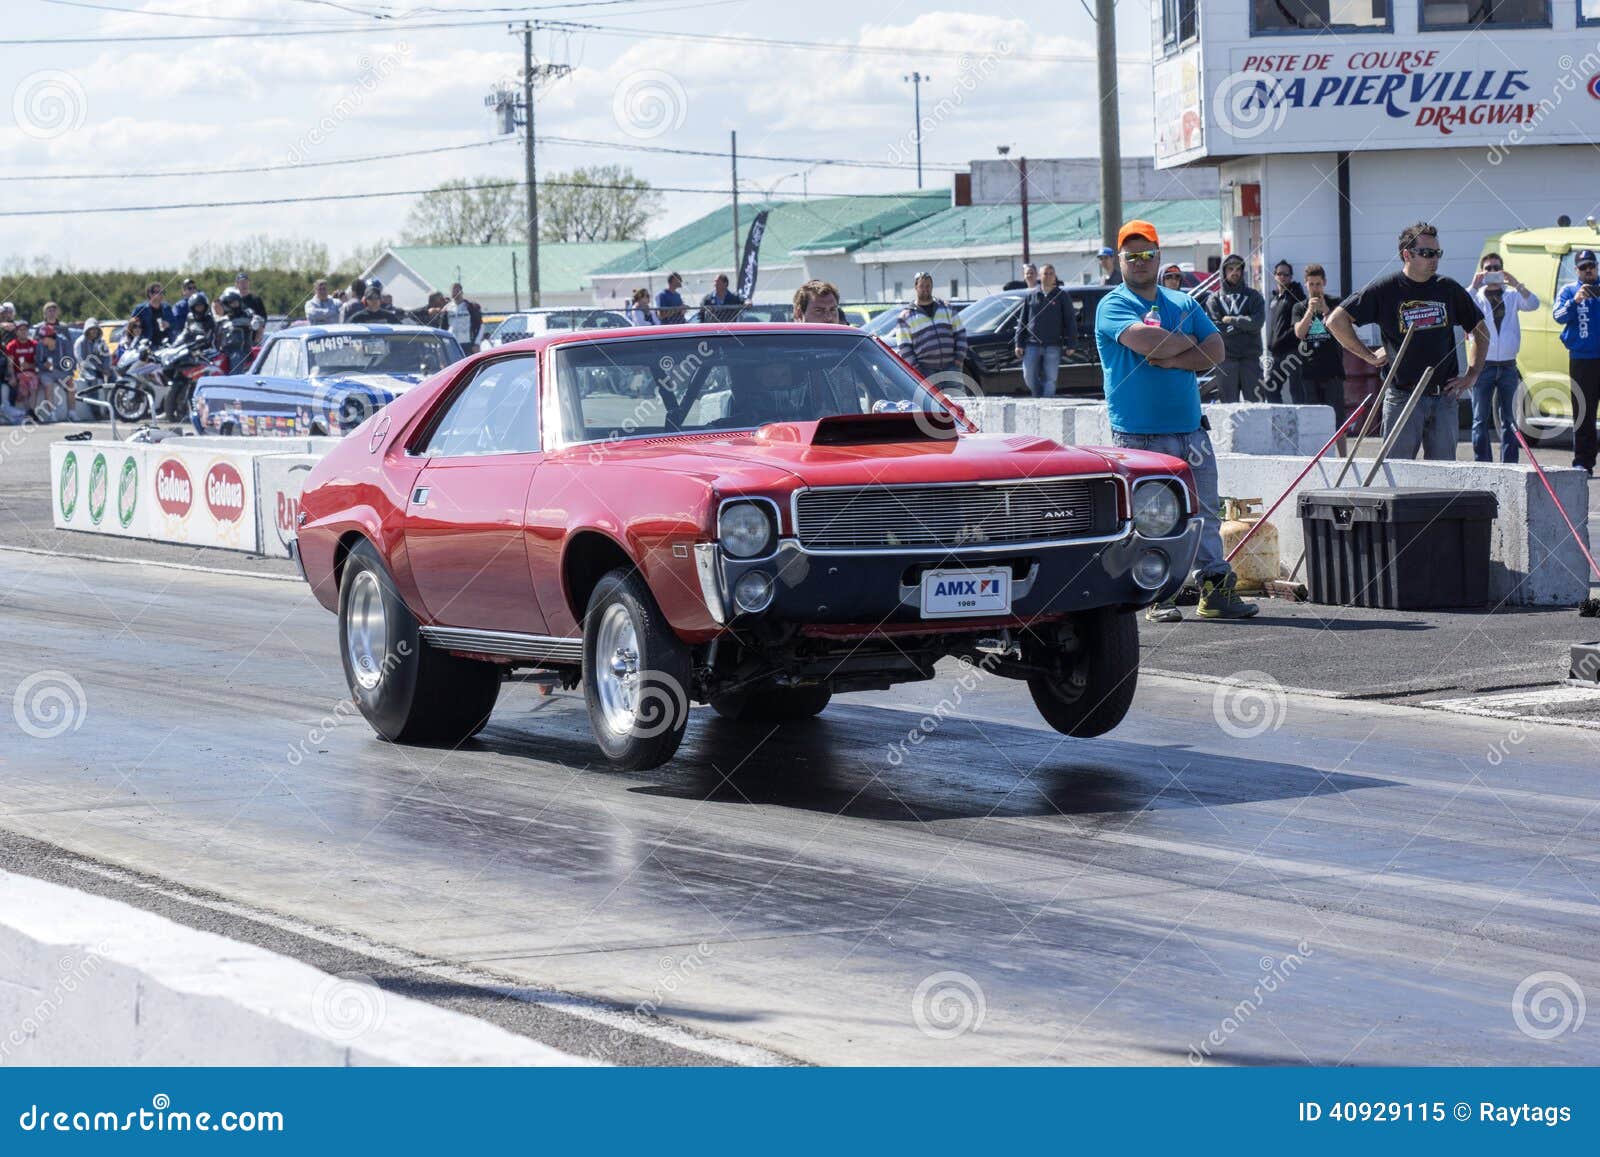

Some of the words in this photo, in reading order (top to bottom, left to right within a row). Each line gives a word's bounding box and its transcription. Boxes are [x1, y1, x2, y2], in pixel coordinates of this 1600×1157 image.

[1243, 55, 1296, 73] PISTE
[1302, 54, 1334, 71] DE
[1348, 50, 1440, 74] COURSE
[1243, 70, 1530, 118] NAPIERVILLE
[1415, 103, 1542, 134] DRAGWAY
[158, 469, 190, 503] Gadoua
[208, 473, 243, 508] Gadoua
[1043, 509, 1074, 519] AMX
[934, 580, 977, 597] AMX
